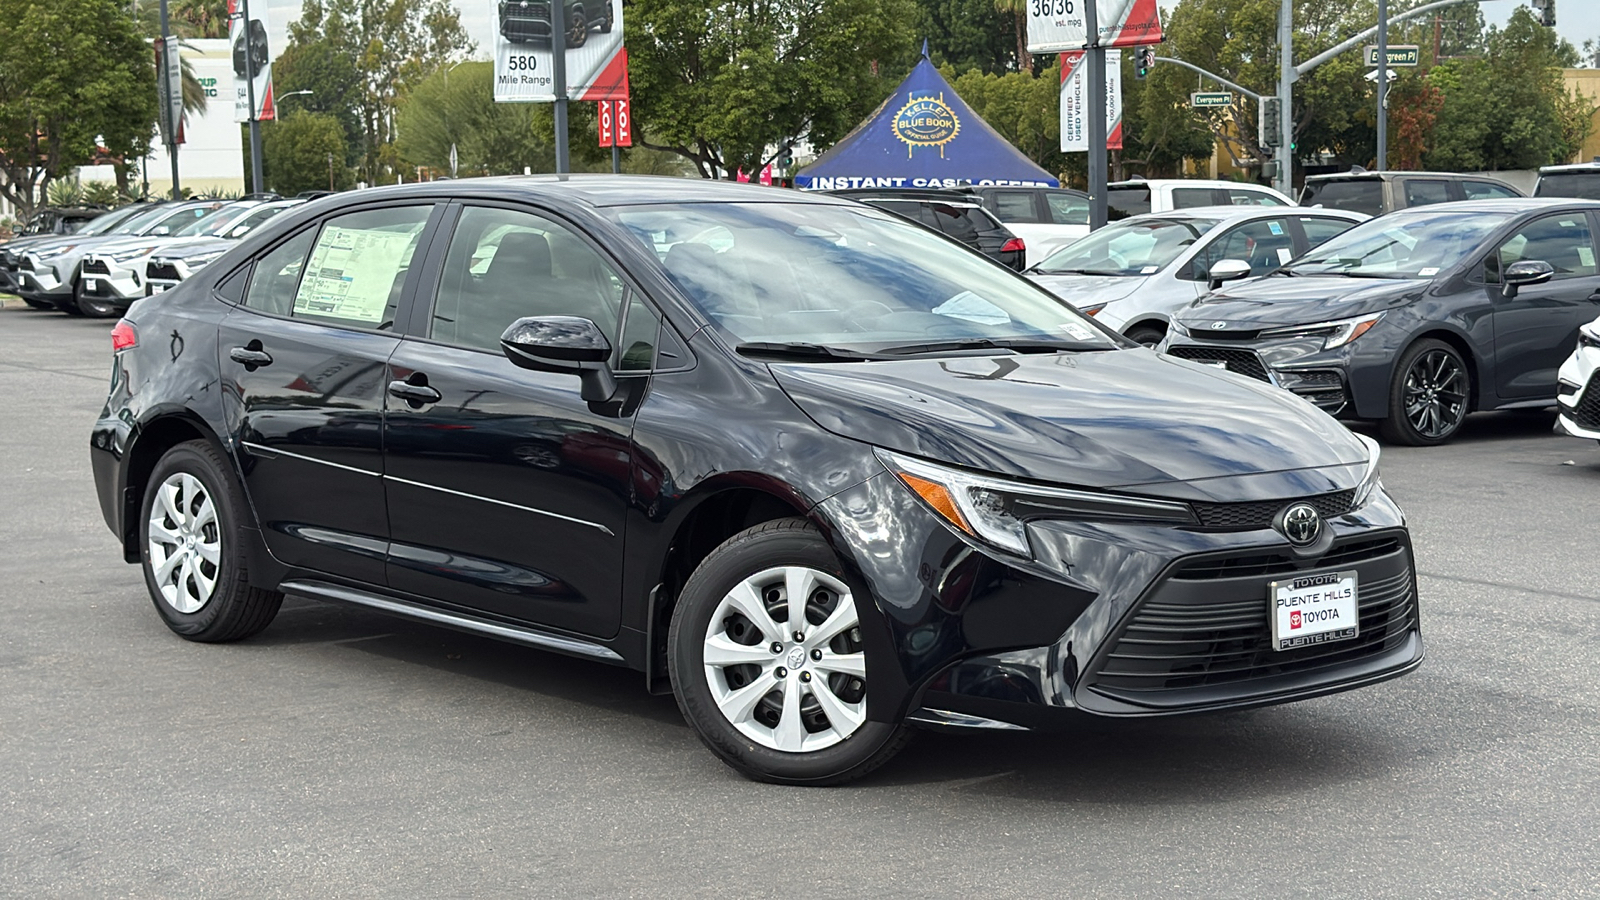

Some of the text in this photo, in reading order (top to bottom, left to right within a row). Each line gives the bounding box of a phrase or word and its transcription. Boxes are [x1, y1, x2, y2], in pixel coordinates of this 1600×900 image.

[1032, 0, 1074, 17] 36/36
[1067, 19, 1082, 28] mpg
[1408, 51, 1416, 61] Pl
[508, 56, 537, 71] 580
[198, 78, 217, 87] OUP
[499, 75, 551, 87] Mile Range
[905, 103, 949, 117] KELLEY
[602, 100, 611, 141] TOY
[618, 100, 628, 141] TOY
[899, 118, 953, 129] BLUE BOOK
[904, 129, 930, 140] OFFICIAL
[812, 176, 906, 190] INSTANT
[1294, 574, 1338, 588] TOYOTA
[1277, 588, 1352, 608] PUENTE HILLS
[1302, 608, 1340, 624] TOYOTA
[1281, 628, 1355, 648] PUENTE HILLS
